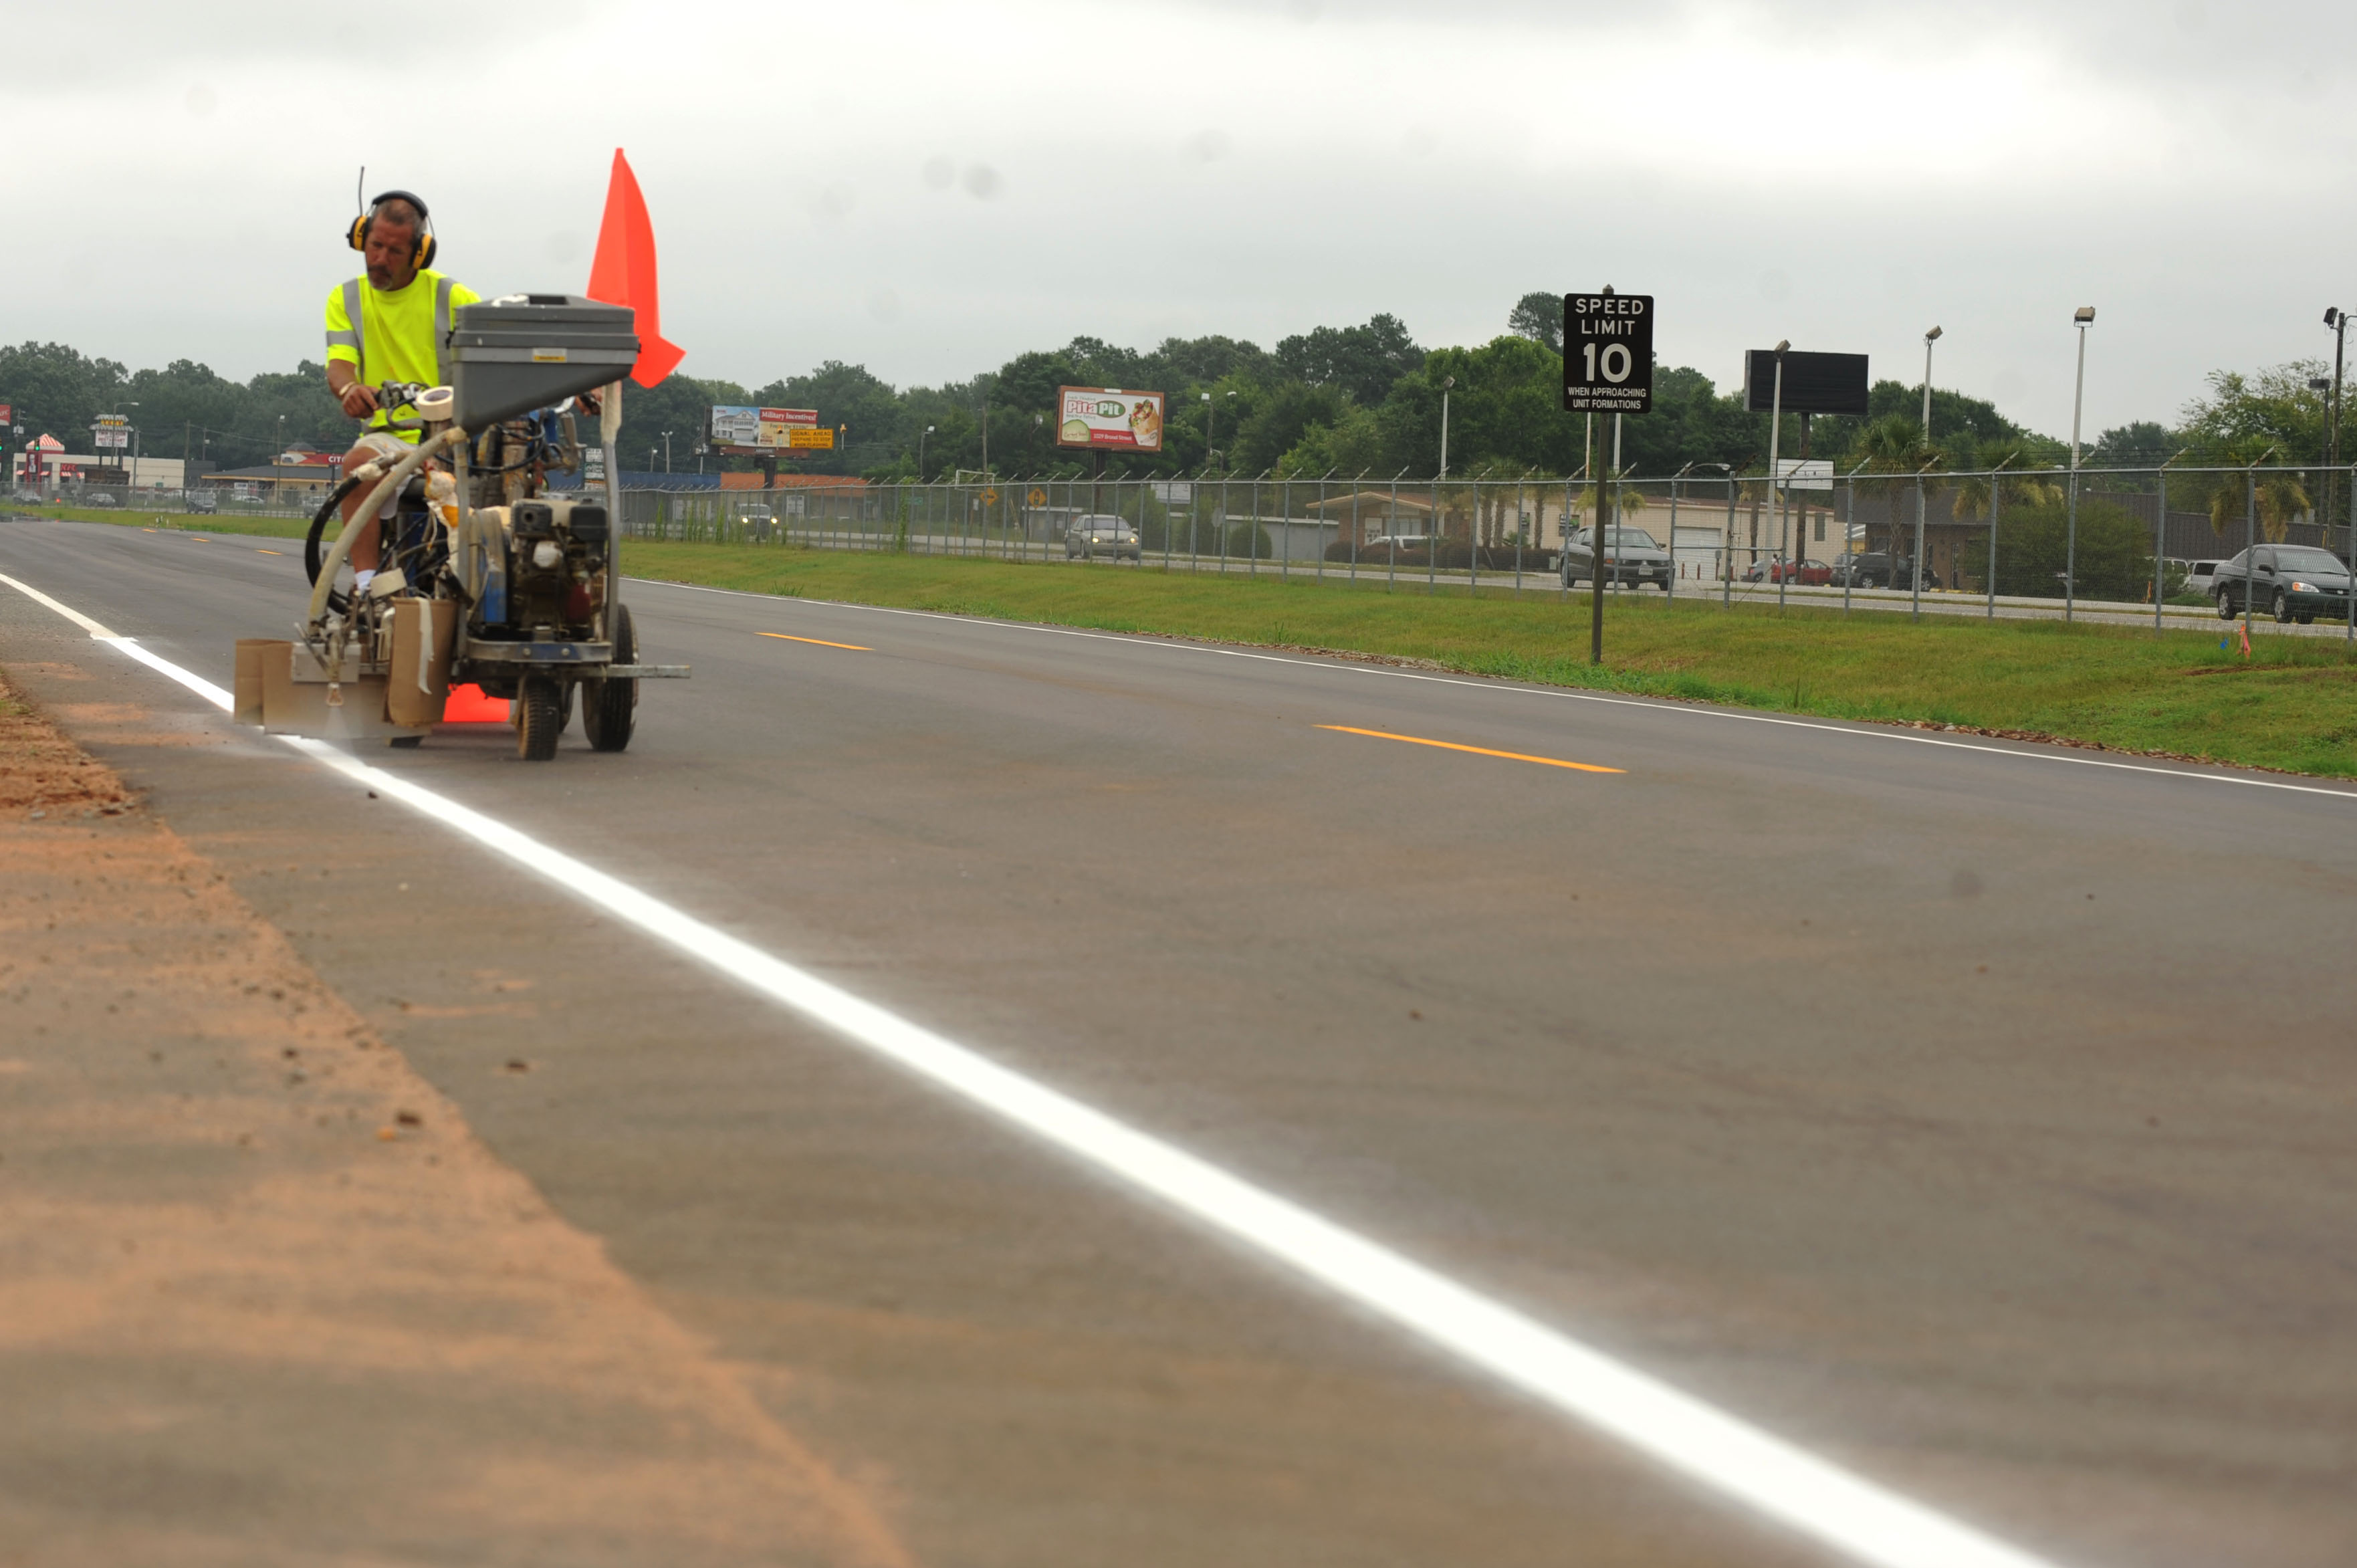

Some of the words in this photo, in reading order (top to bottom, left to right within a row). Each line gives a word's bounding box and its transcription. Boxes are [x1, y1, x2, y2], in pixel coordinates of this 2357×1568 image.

[1575, 298, 1644, 314] SPEED
[1581, 319, 1636, 335] LIMIT
[1583, 342, 1632, 383] 10
[1568, 386, 1590, 396] WHEN
[1591, 387, 1646, 397] APPROACHING
[1067, 401, 1097, 414] Pita
[1099, 403, 1120, 415] Pit
[1573, 399, 1590, 408] UNIT
[1592, 399, 1642, 409] FORMATIONS
[762, 411, 784, 421] Military
[786, 412, 816, 421] Incentives!
